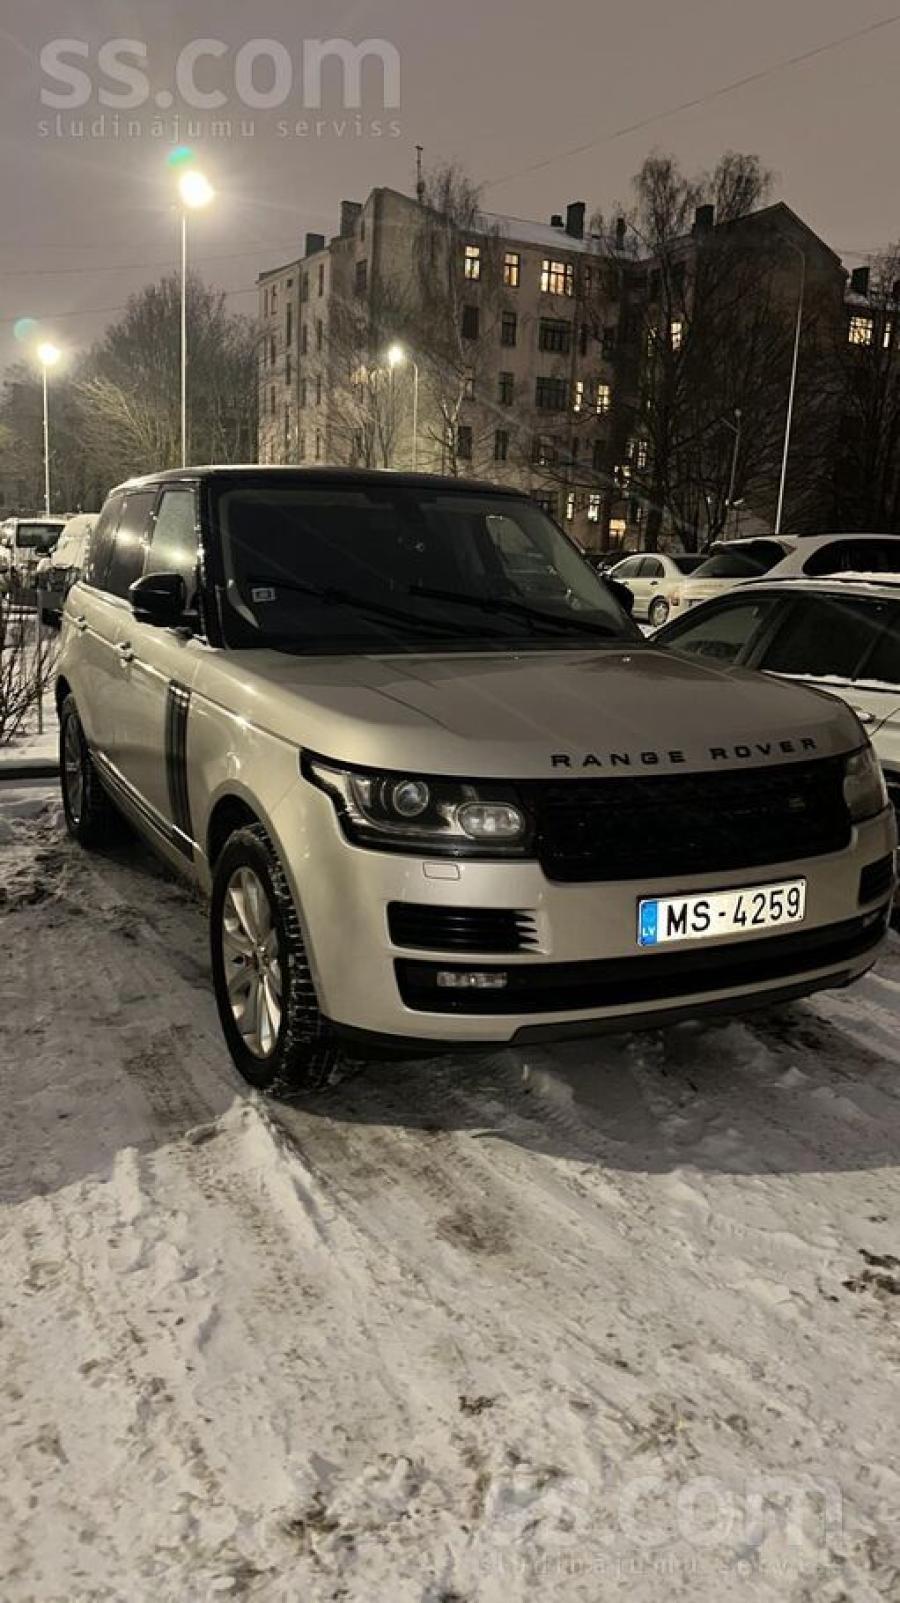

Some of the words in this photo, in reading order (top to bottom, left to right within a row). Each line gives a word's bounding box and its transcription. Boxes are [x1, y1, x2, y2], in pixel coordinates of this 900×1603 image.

[551, 752, 685, 768] RANGE
[710, 739, 817, 760] ROVER
[667, 888, 800, 936] MS-4259
